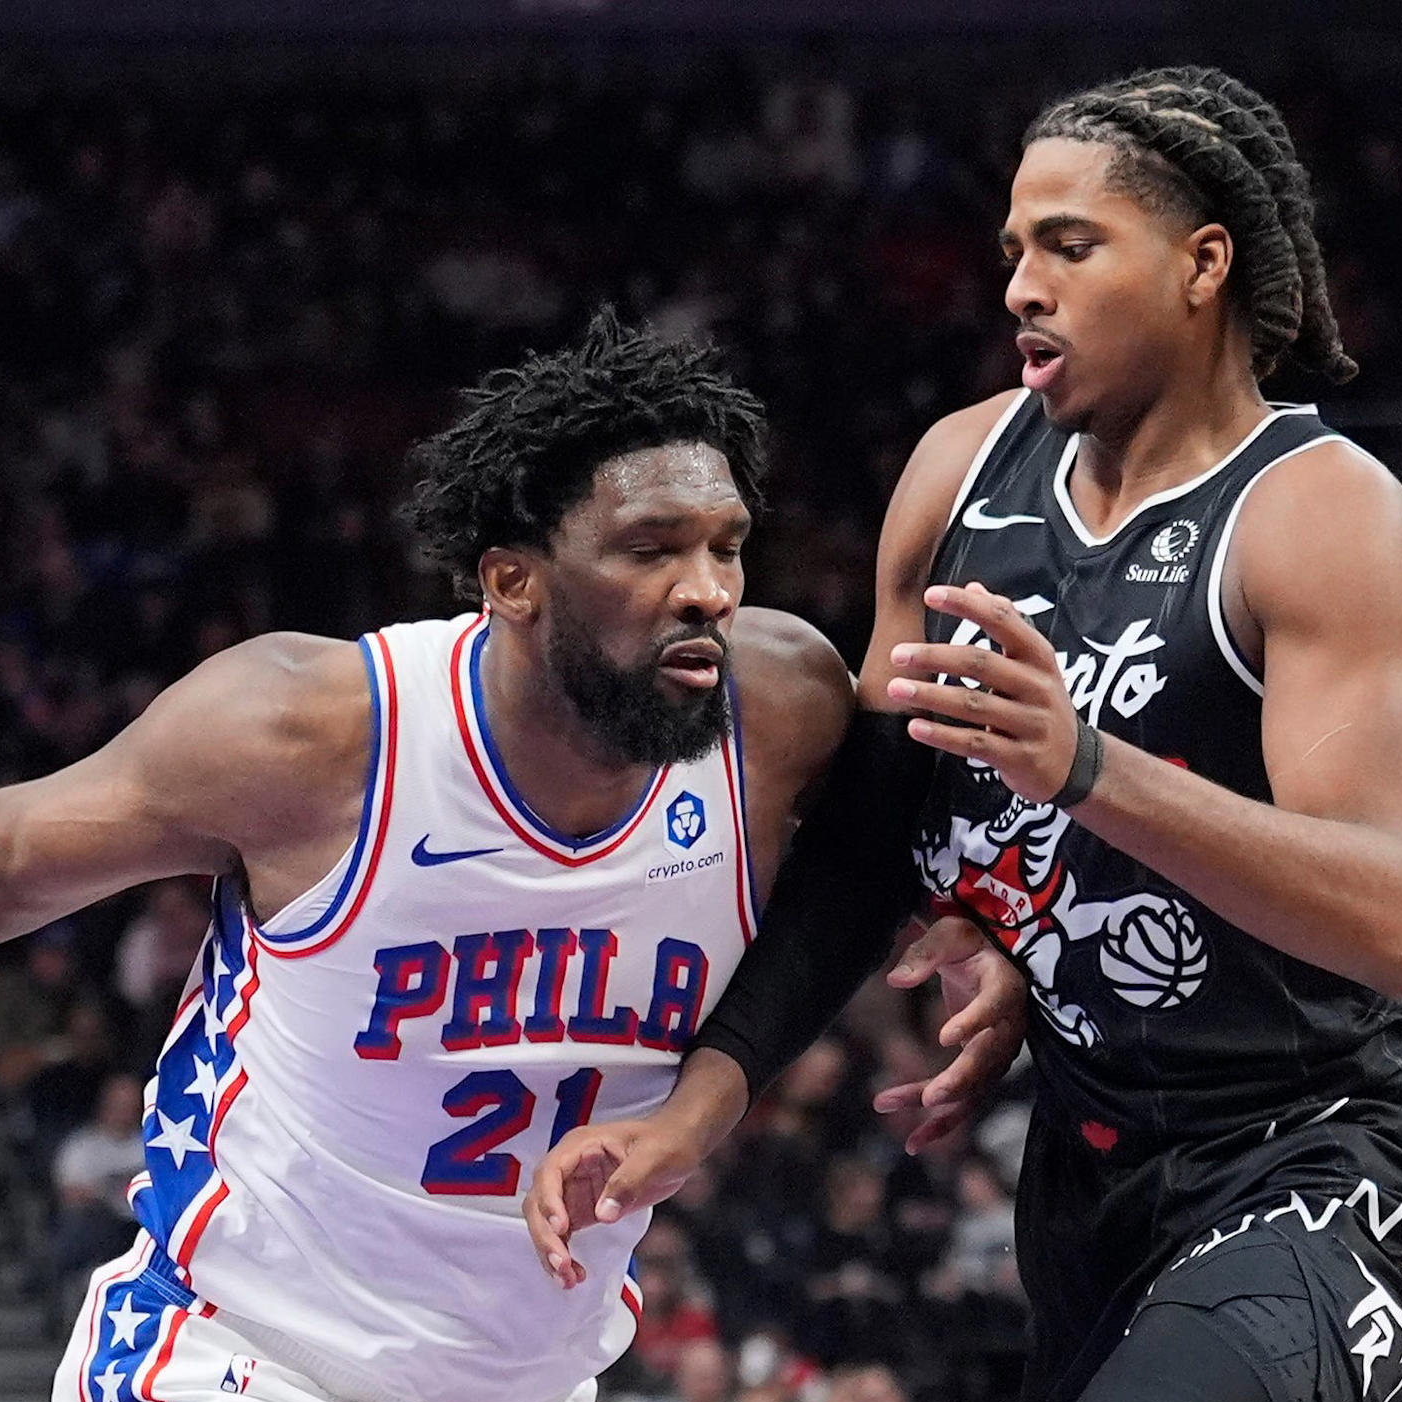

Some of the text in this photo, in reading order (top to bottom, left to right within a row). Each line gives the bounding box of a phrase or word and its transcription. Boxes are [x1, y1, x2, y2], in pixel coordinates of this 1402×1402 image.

[1125, 564, 1189, 582] Sun Life
[648, 851, 724, 879] crypto.com
[353, 928, 709, 1061] PHILA
